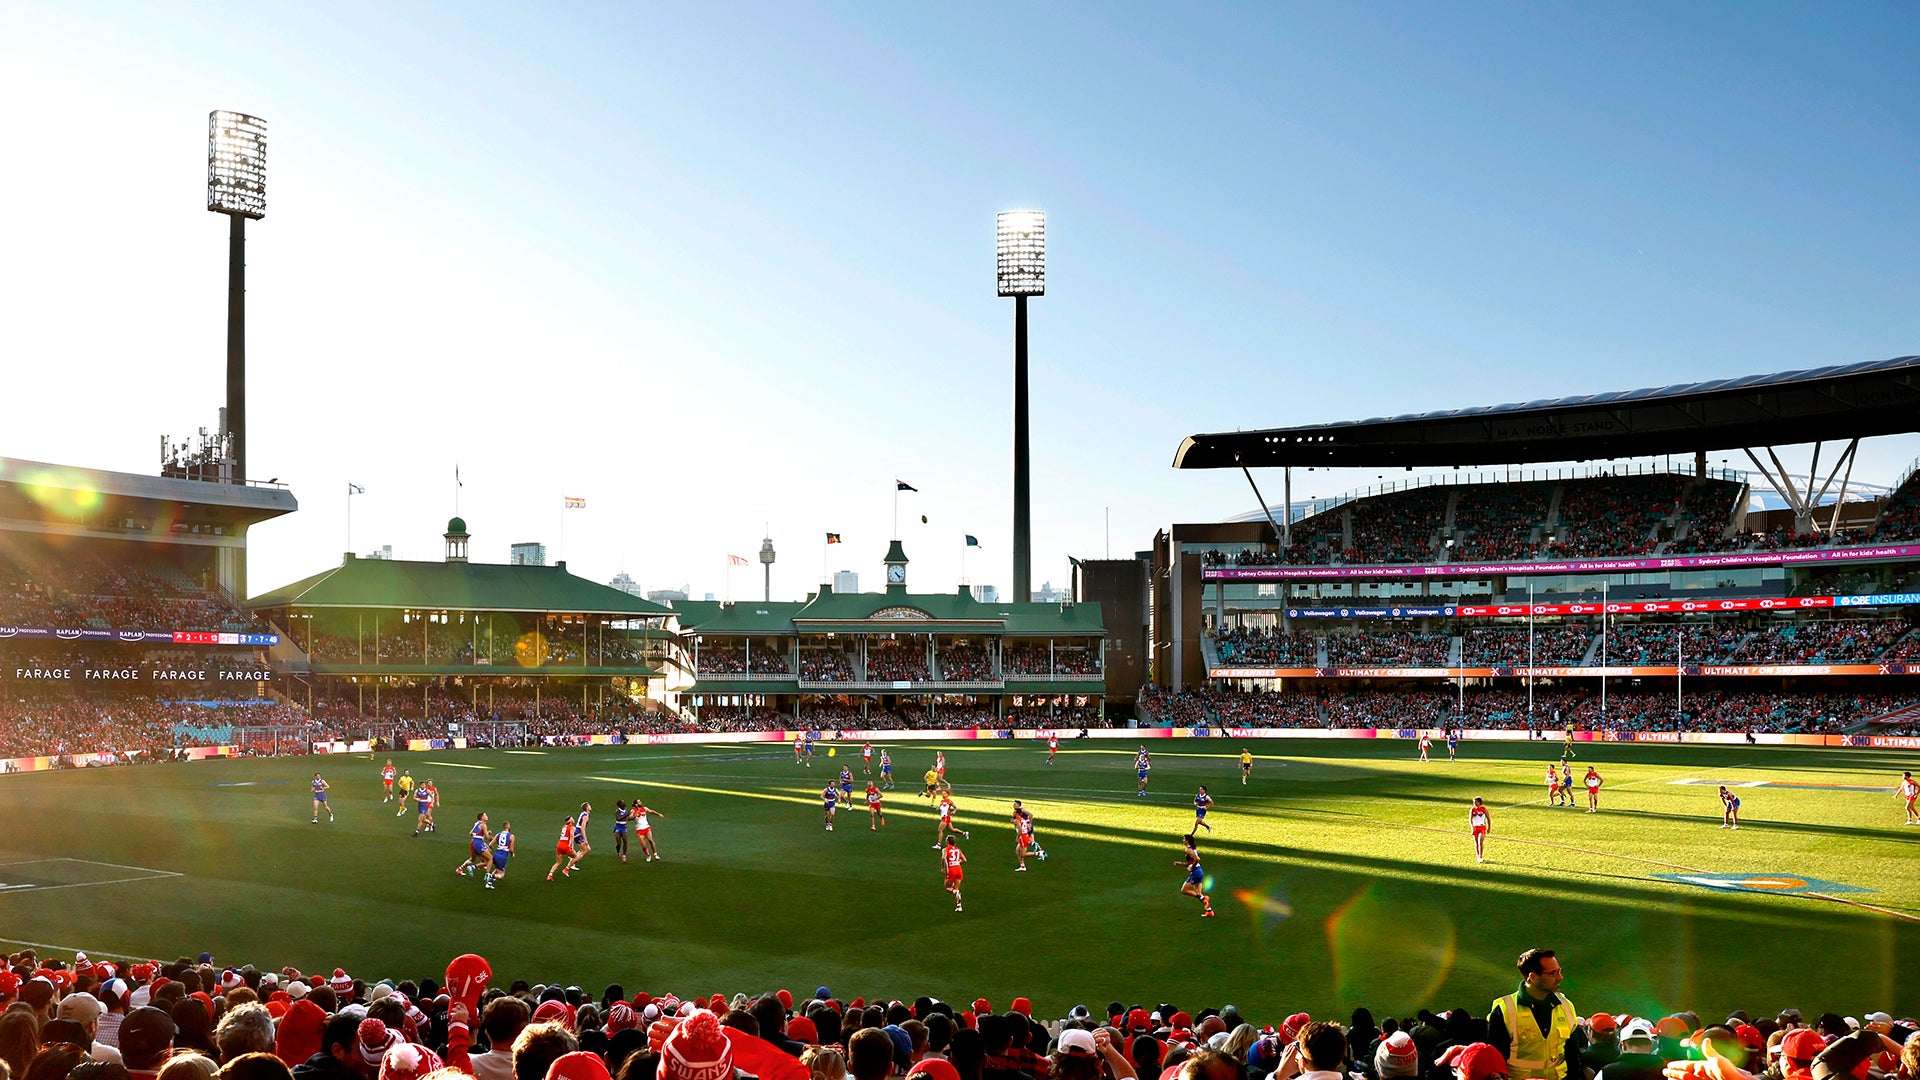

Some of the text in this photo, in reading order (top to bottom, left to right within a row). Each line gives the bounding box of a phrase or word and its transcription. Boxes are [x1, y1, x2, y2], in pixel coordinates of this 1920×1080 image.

[1511, 428, 1520, 438] A
[1527, 424, 1567, 436] NOBLE
[1573, 421, 1614, 433] STAND
[1618, 560, 1637, 568] health
[1698, 558, 1719, 566] Sydney
[1752, 554, 1781, 563] Hospitals
[1782, 553, 1818, 561] Foundation
[1508, 564, 1533, 572] Hospitals
[1534, 563, 1567, 571] Foundation
[1285, 569, 1308, 577] Hospitals
[1850, 596, 1871, 605] QBE
[1303, 609, 1335, 617] Volkswagen
[1406, 608, 1439, 616] Volkswagen
[16, 668, 71, 679] FARAGE
[85, 669, 139, 680] FARAGE
[152, 670, 206, 681] FARAGE
[1231, 669, 1277, 677] SWANNIES
[1339, 669, 1379, 677] ULTIMATE
[1402, 668, 1450, 676] SWANNIES
[1516, 668, 1559, 676] ULTIMATE
[1581, 668, 1633, 676] SWANNIES
[1703, 667, 1749, 675] ULTIMATE
[1775, 666, 1832, 674] SWANNIES
[219, 671, 271, 681] FARAGE
[1194, 728, 1210, 737] OMO
[1399, 729, 1416, 738] OMO
[1638, 732, 1690, 742] ULTIMAE
[430, 739, 446, 749] OMO
[1852, 735, 1871, 746] OMO
[498, 833, 508, 846] 19
[949, 848, 962, 861] 37
[475, 970, 489, 984] QBE
[669, 1058, 727, 1080] SWANS
